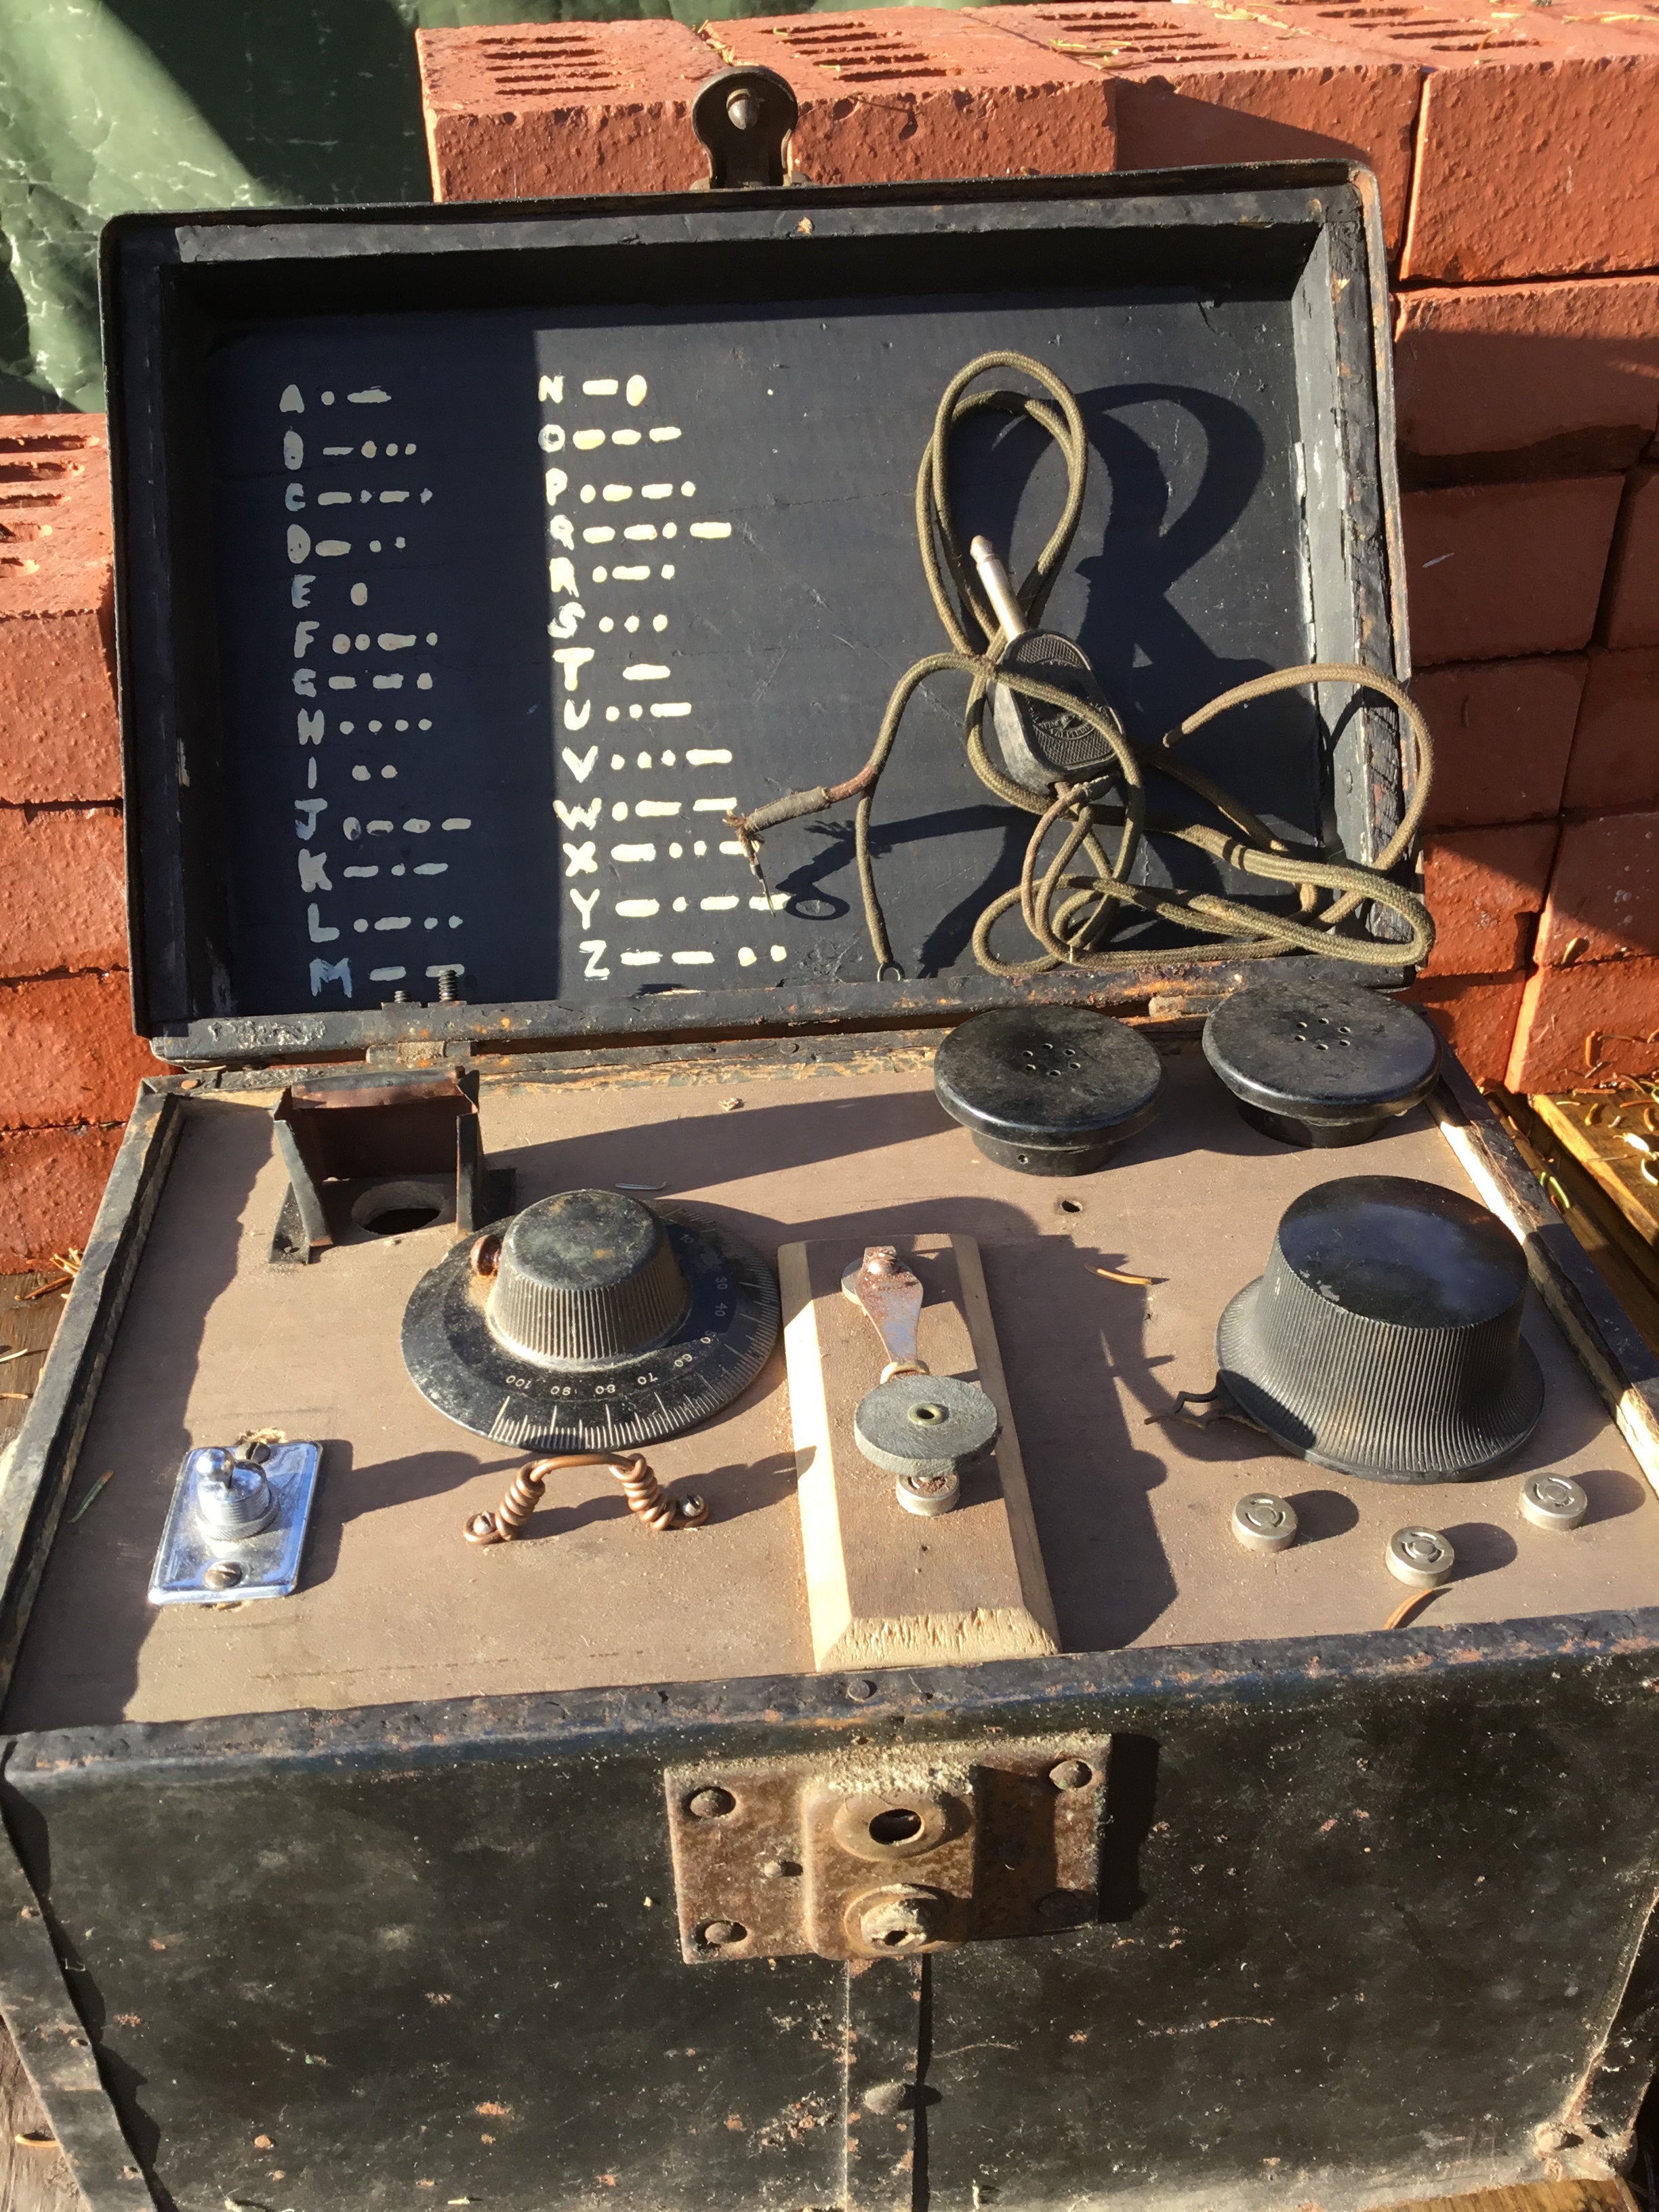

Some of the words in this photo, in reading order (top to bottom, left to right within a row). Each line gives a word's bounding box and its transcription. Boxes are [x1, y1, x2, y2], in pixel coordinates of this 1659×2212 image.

[279, 384, 304, 413] A
[539, 375, 565, 403] N
[283, 430, 304, 470] B
[538, 424, 565, 453] O
[285, 483, 306, 511] C
[546, 468, 567, 506] P
[287, 525, 310, 564] D
[550, 514, 574, 550] Q
[291, 575, 316, 609] E
[550, 557, 579, 597] R
[548, 602, 586, 638] S
[294, 621, 319, 657] F
[292, 668, 316, 697] G
[552, 647, 594, 691] T
[298, 708, 325, 745] H
[564, 699, 590, 731] U
[308, 757, 316, 789] I
[562, 745, 598, 783] V
[295, 798, 327, 840] J
[554, 798, 602, 831] W
[298, 848, 332, 892] K
[563, 842, 598, 877] X
[308, 903, 340, 943] L
[570, 888, 600, 930] Y
[579, 940, 610, 980] Z
[309, 958, 352, 998] M
[679, 1233, 695, 1244] 10
[714, 1303, 728, 1317] 40
[674, 1353, 693, 1368] 60
[506, 1375, 533, 1389] 100
[550, 1386, 571, 1396] 90
[595, 1384, 616, 1395] 80
[637, 1372, 658, 1385] 70
